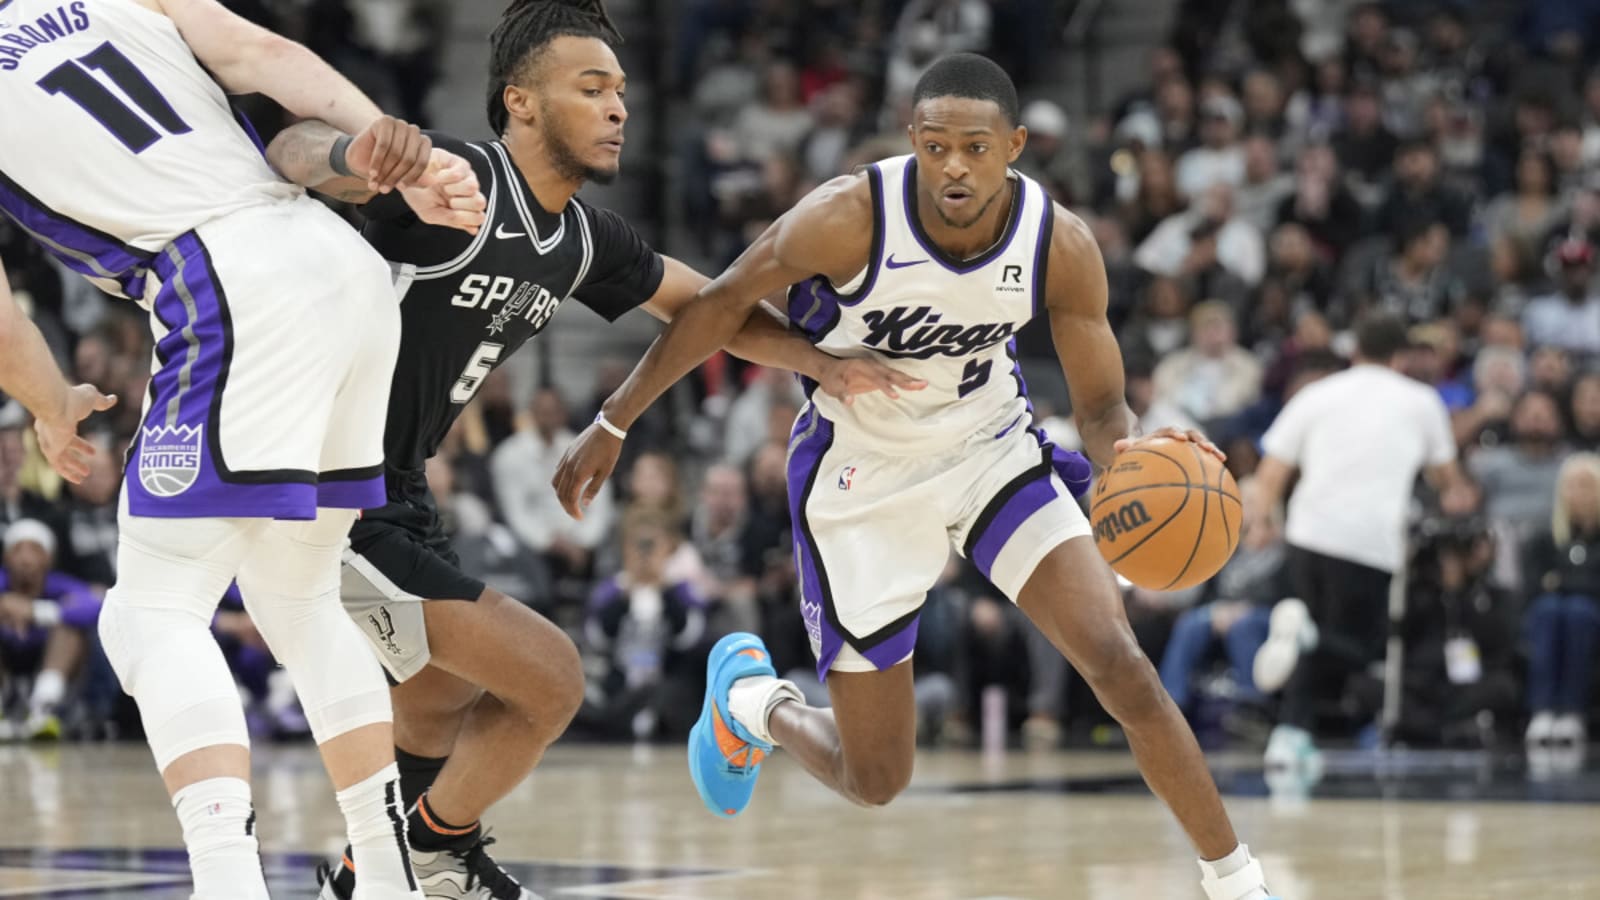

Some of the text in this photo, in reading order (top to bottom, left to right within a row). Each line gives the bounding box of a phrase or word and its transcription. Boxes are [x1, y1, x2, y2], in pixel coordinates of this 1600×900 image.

[0, 1, 90, 71] SABONIS
[35, 40, 194, 155] 11
[451, 273, 560, 336] SPURS
[861, 306, 1016, 359] Kings
[450, 341, 504, 404] 5
[141, 454, 197, 468] KINGS
